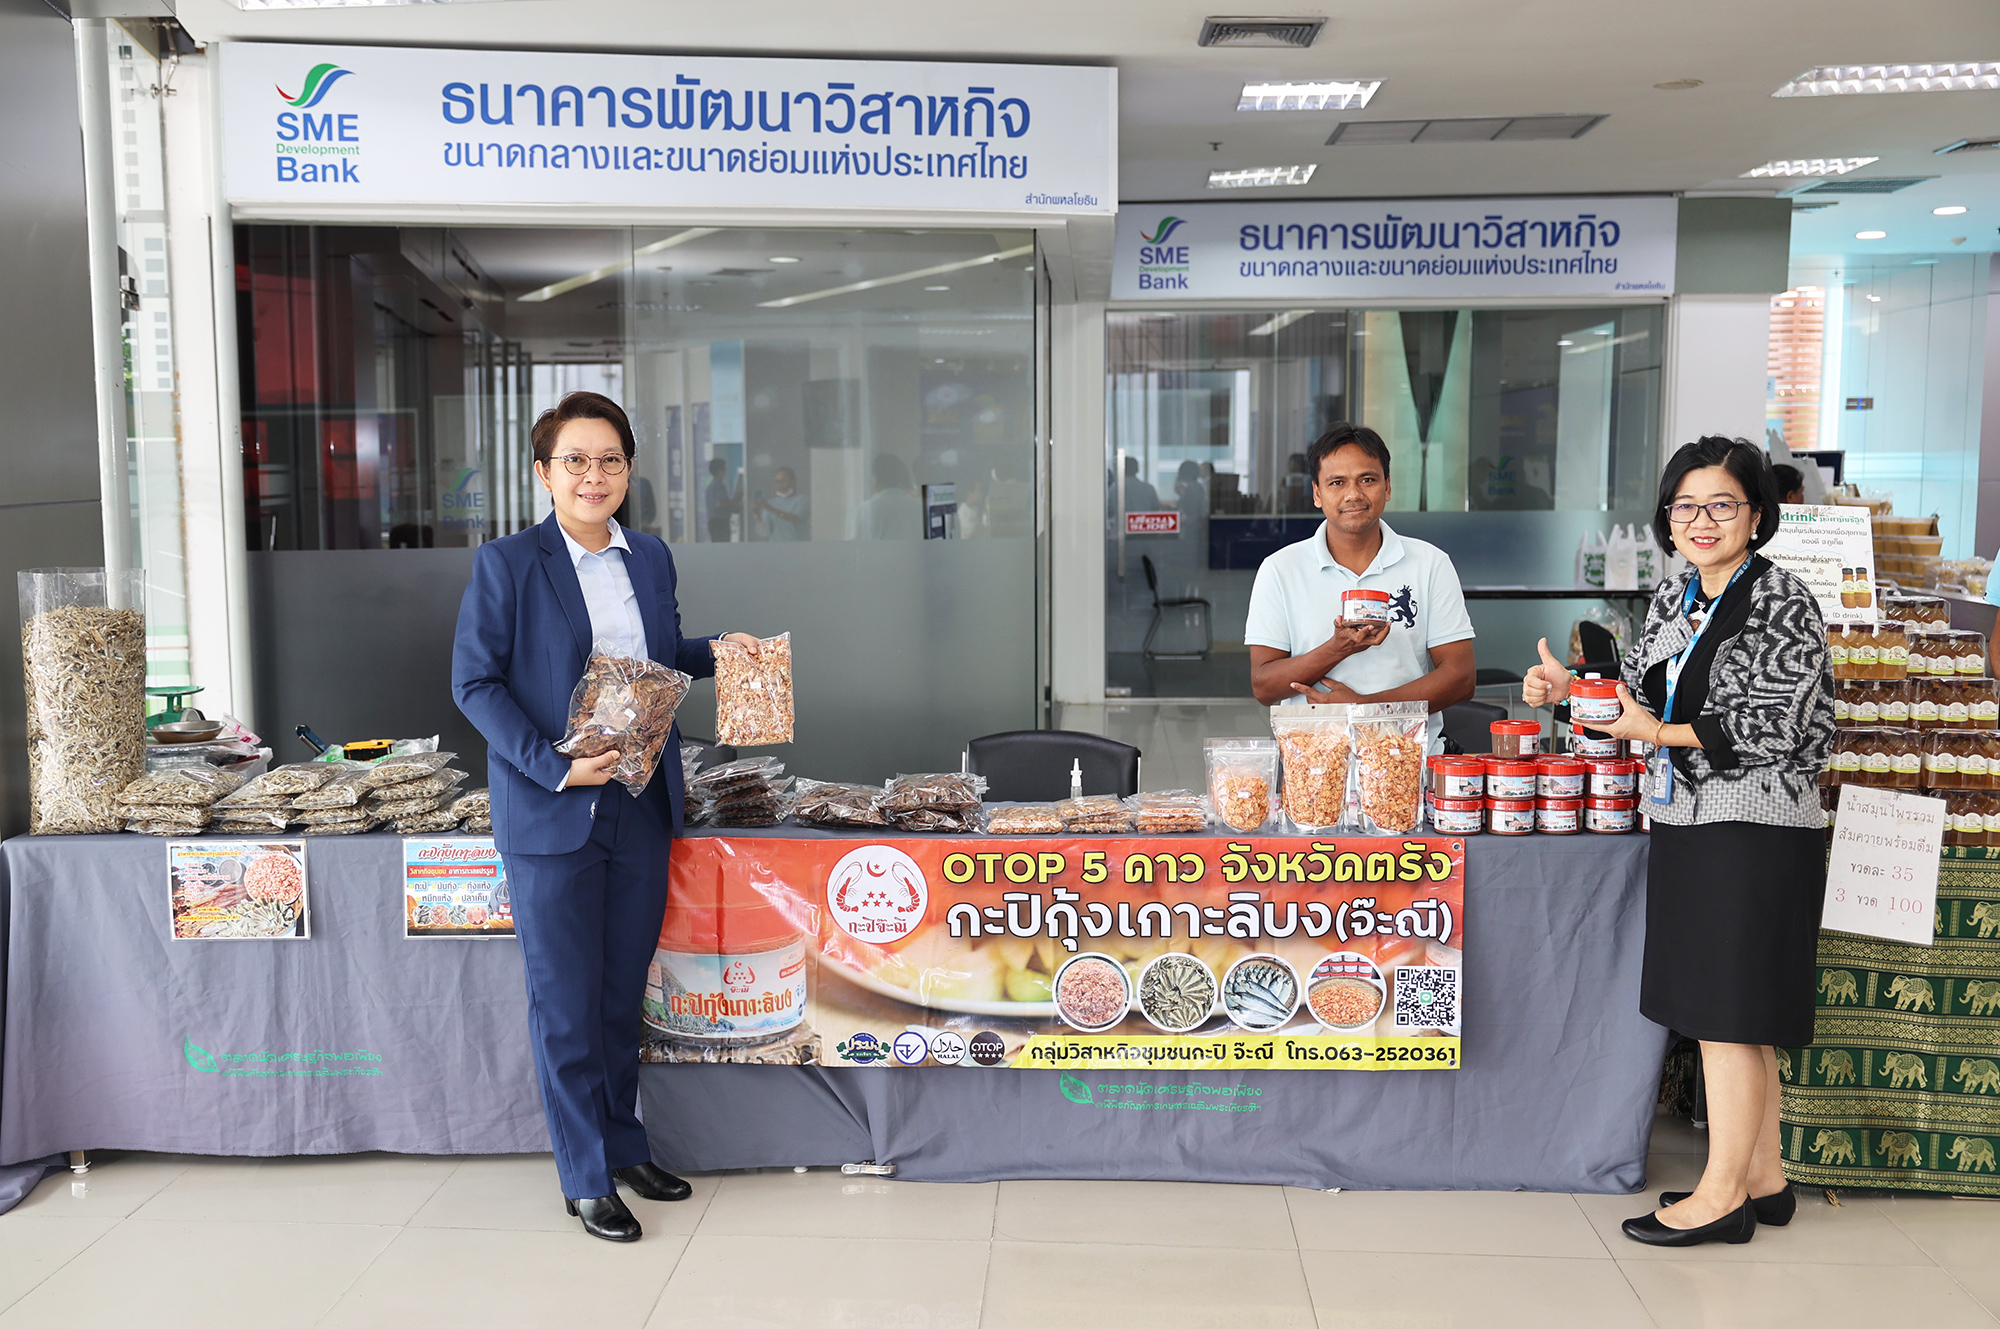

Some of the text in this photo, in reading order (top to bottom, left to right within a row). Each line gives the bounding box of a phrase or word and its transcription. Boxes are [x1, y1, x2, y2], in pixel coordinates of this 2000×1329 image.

[441, 73, 1031, 138] ธนาคารพัฒนาวิสาหกิจ
[276, 112, 360, 142] SME
[276, 143, 361, 156] Development
[443, 138, 1029, 182] ขนาดกลางและขนาดย่อมแห่งประเทศไทย
[276, 156, 360, 184] Bank
[1025, 191, 1098, 206] สำนักพหลโยธิน
[1239, 214, 1621, 251] ธนาคารพัฒนาวิสาหกิจ
[1139, 246, 1190, 265] SME
[1239, 250, 1619, 279] ขนาดกลางและขนาดย่อมแห่งประเทศไทย
[1139, 264, 1190, 273] Development
[1139, 272, 1190, 290] Bank
[442, 492, 485, 509] SME
[443, 514, 486, 530] Bank
[1838, 826, 1935, 854] ส้มควายพร้อมดื่ม
[942, 841, 1453, 885] OTOP 5 ดาว จังหวัดตรัง
[1850, 862, 1914, 882] ขวดละ 35
[1835, 887, 1923, 914] 3 ขวด 100
[670, 988, 793, 1024] กะปิกุ้งเกาะลิบง
[221, 1049, 383, 1065] ตลาดนัดเศรษฐกิจพอเพียง
[971, 1042, 1003, 1052] OTOP
[1031, 1042, 1226, 1064] กลุ่มวิสาหกิจชุมชนกะปิ
[1097, 1081, 1263, 1097] ตลาดนัดเศรษฐกิจพอเพียง
